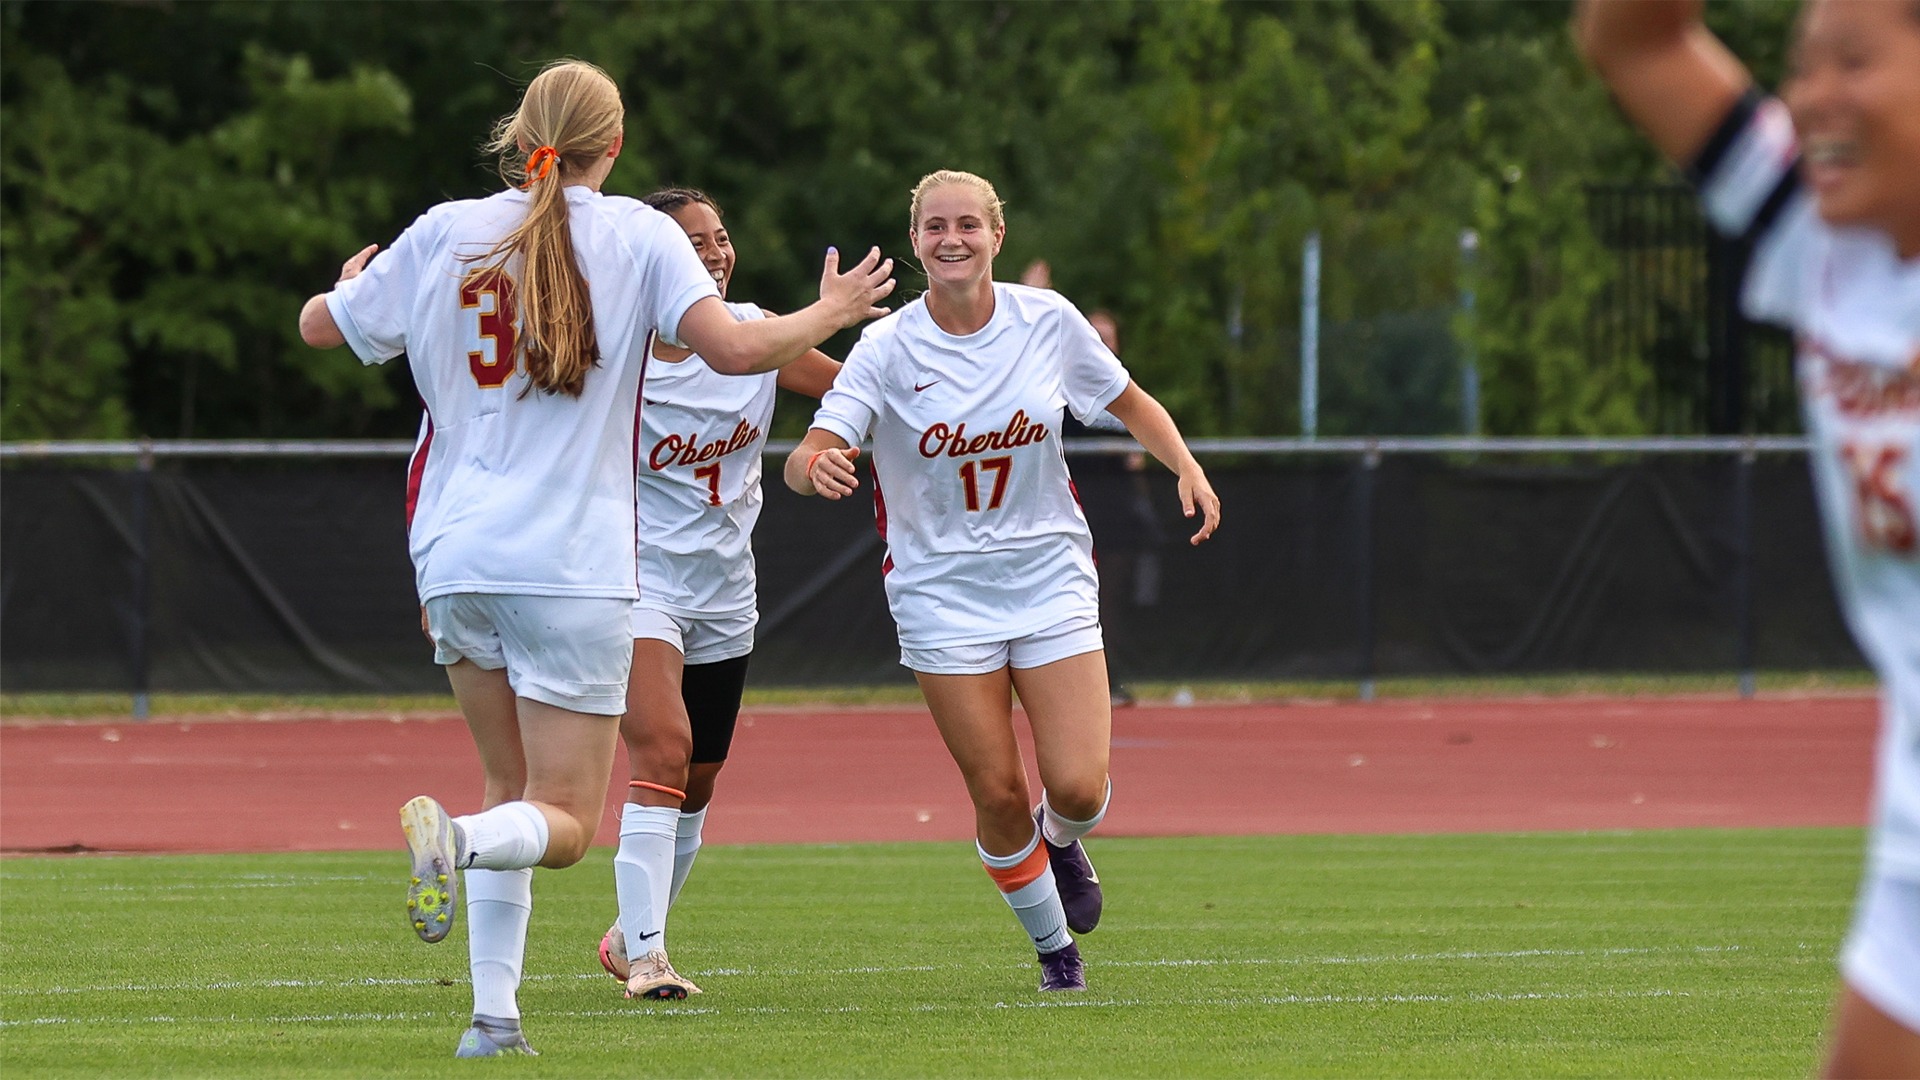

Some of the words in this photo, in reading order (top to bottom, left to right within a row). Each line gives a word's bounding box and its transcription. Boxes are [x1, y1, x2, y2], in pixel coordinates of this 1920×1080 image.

[648, 417, 761, 472] Oberlin
[918, 408, 1049, 459] Oberlin
[694, 461, 723, 507] 7
[959, 455, 1013, 512] 17
